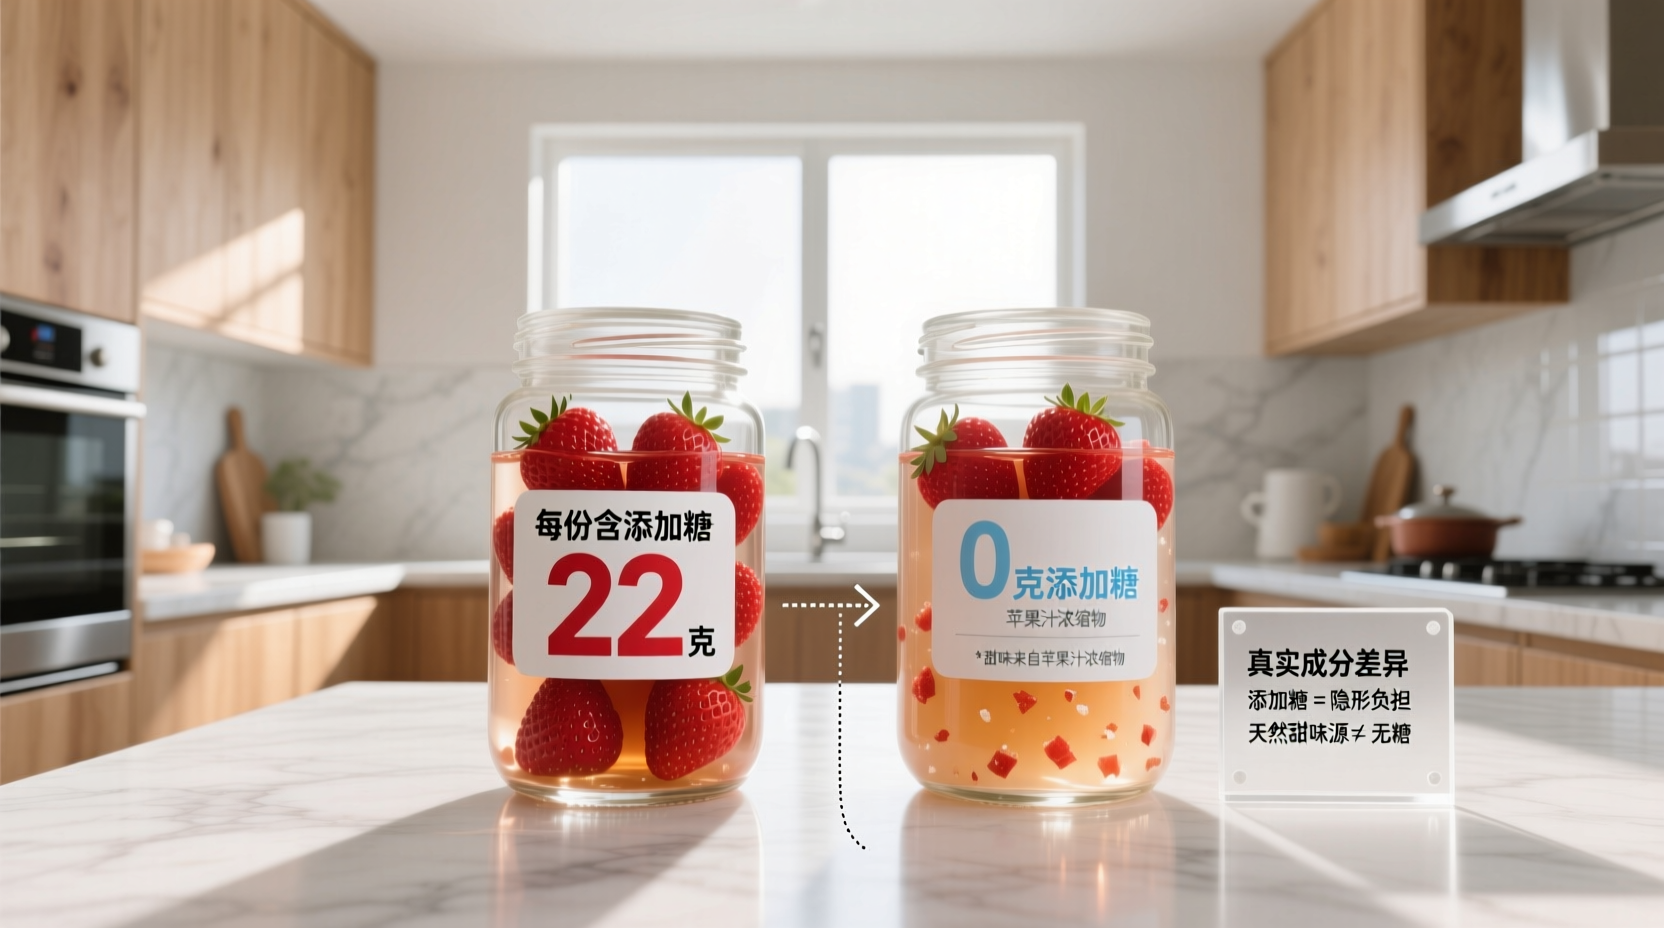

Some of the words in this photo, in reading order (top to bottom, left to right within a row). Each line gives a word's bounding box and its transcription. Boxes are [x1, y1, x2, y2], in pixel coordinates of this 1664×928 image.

[535, 508, 713, 542] 每份含添加糖
[1247, 648, 1409, 677] 真实成分差异
[1248, 689, 1308, 711] 添加糖
[1331, 688, 1412, 711] 隐形负担
[1371, 722, 1412, 745] 无糖
